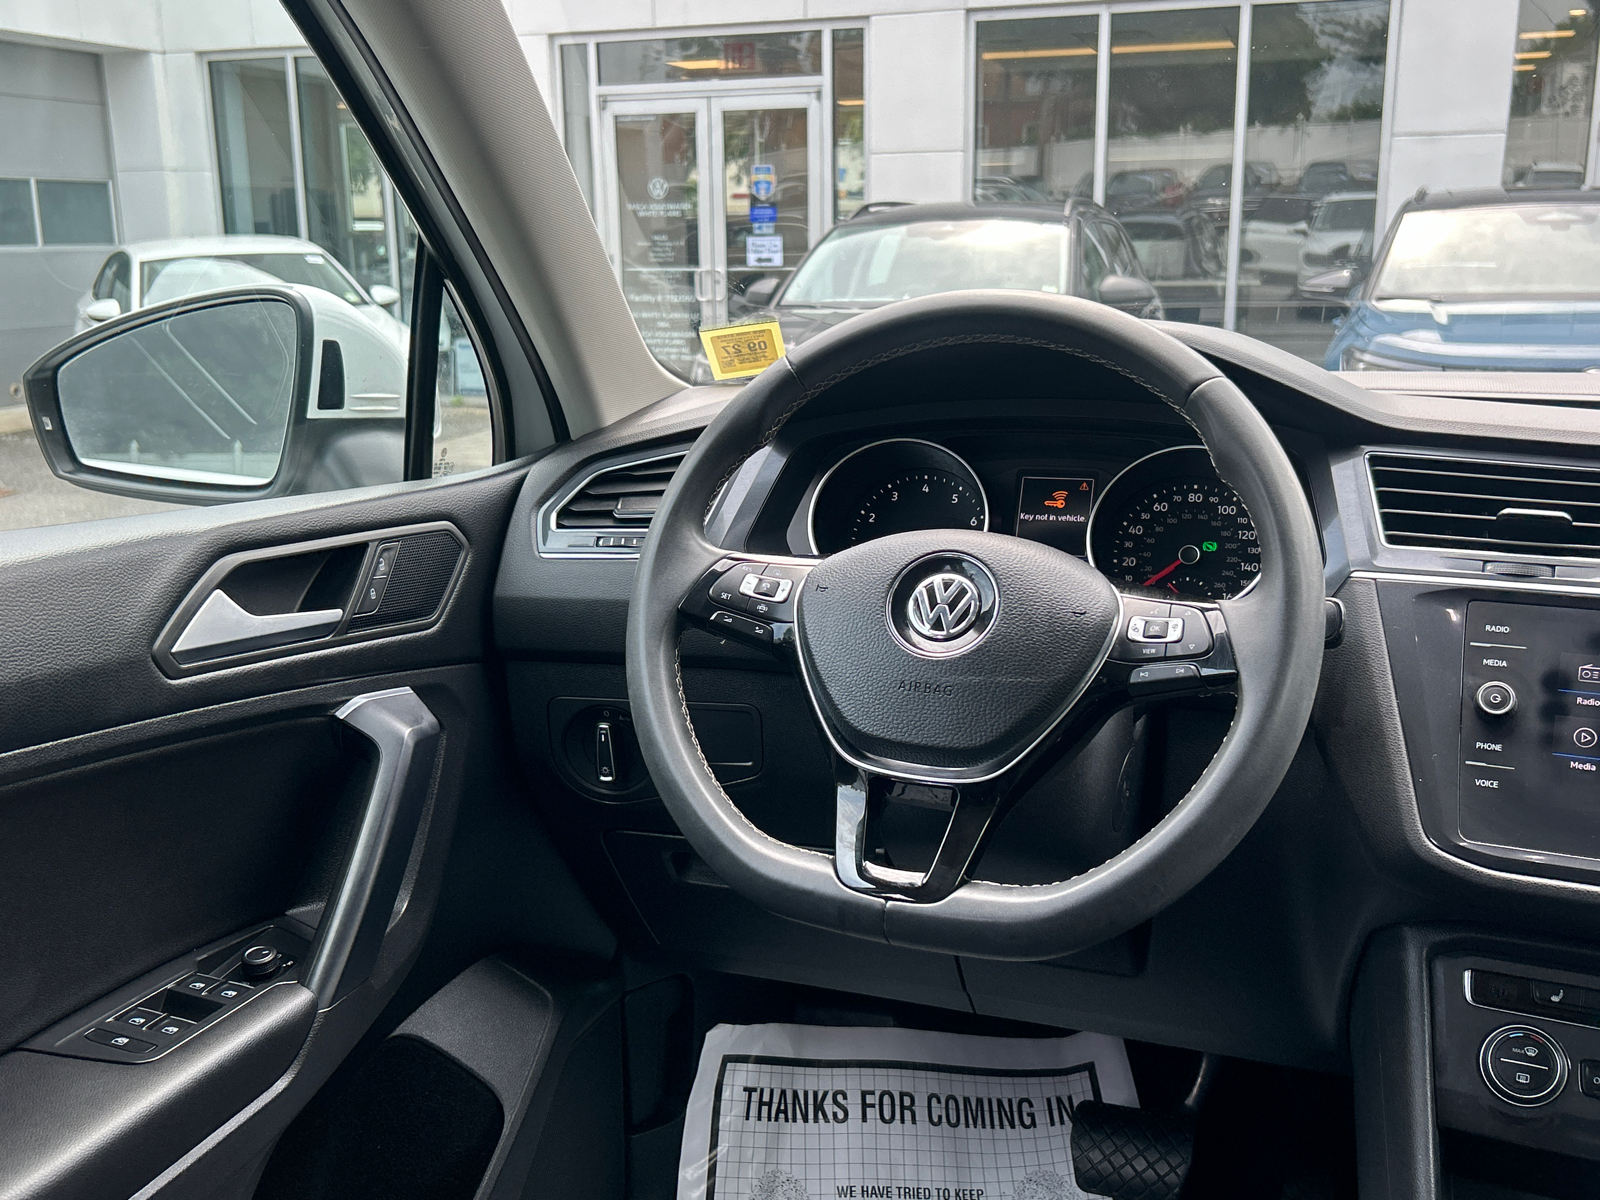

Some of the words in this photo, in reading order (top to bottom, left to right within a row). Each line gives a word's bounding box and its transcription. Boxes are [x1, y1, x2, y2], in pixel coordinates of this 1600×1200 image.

[921, 484, 930, 494] 4
[891, 492, 899, 502] 3
[951, 494, 959, 505] 5
[1187, 493, 1203, 503] 80
[1208, 496, 1219, 504] 90
[1152, 502, 1168, 512] 60
[1217, 505, 1237, 515] 100
[868, 513, 876, 524] 2
[969, 517, 978, 527] 6
[1020, 512, 1034, 522] Key
[1035, 513, 1048, 521] not
[1049, 513, 1056, 521] in
[1237, 517, 1248, 525] 110
[1128, 525, 1144, 535] 40
[1237, 530, 1256, 540] 120
[1247, 547, 1260, 555] 130
[1122, 557, 1137, 567] 20
[1240, 562, 1259, 572] 140
[720, 592, 732, 600] SET
[1149, 624, 1161, 632] OK
[1485, 624, 1510, 634] RADIO
[1482, 658, 1508, 668] MEDIA
[897, 680, 954, 697] AIRBAG
[1576, 696, 1600, 707] Radio
[1475, 741, 1503, 752] PHONE
[1570, 761, 1597, 772] Media
[1475, 778, 1499, 789] VOICE
[743, 1086, 849, 1124] THANKS
[861, 1089, 917, 1125] FOR
[927, 1092, 1038, 1130] COMING
[1045, 1094, 1076, 1127] IN
[836, 1185, 857, 1198] WE
[861, 1185, 893, 1199] HAVE
[896, 1186, 931, 1200] TRIED
[935, 1188, 950, 1200] TO
[954, 1188, 984, 1200] KEEP
